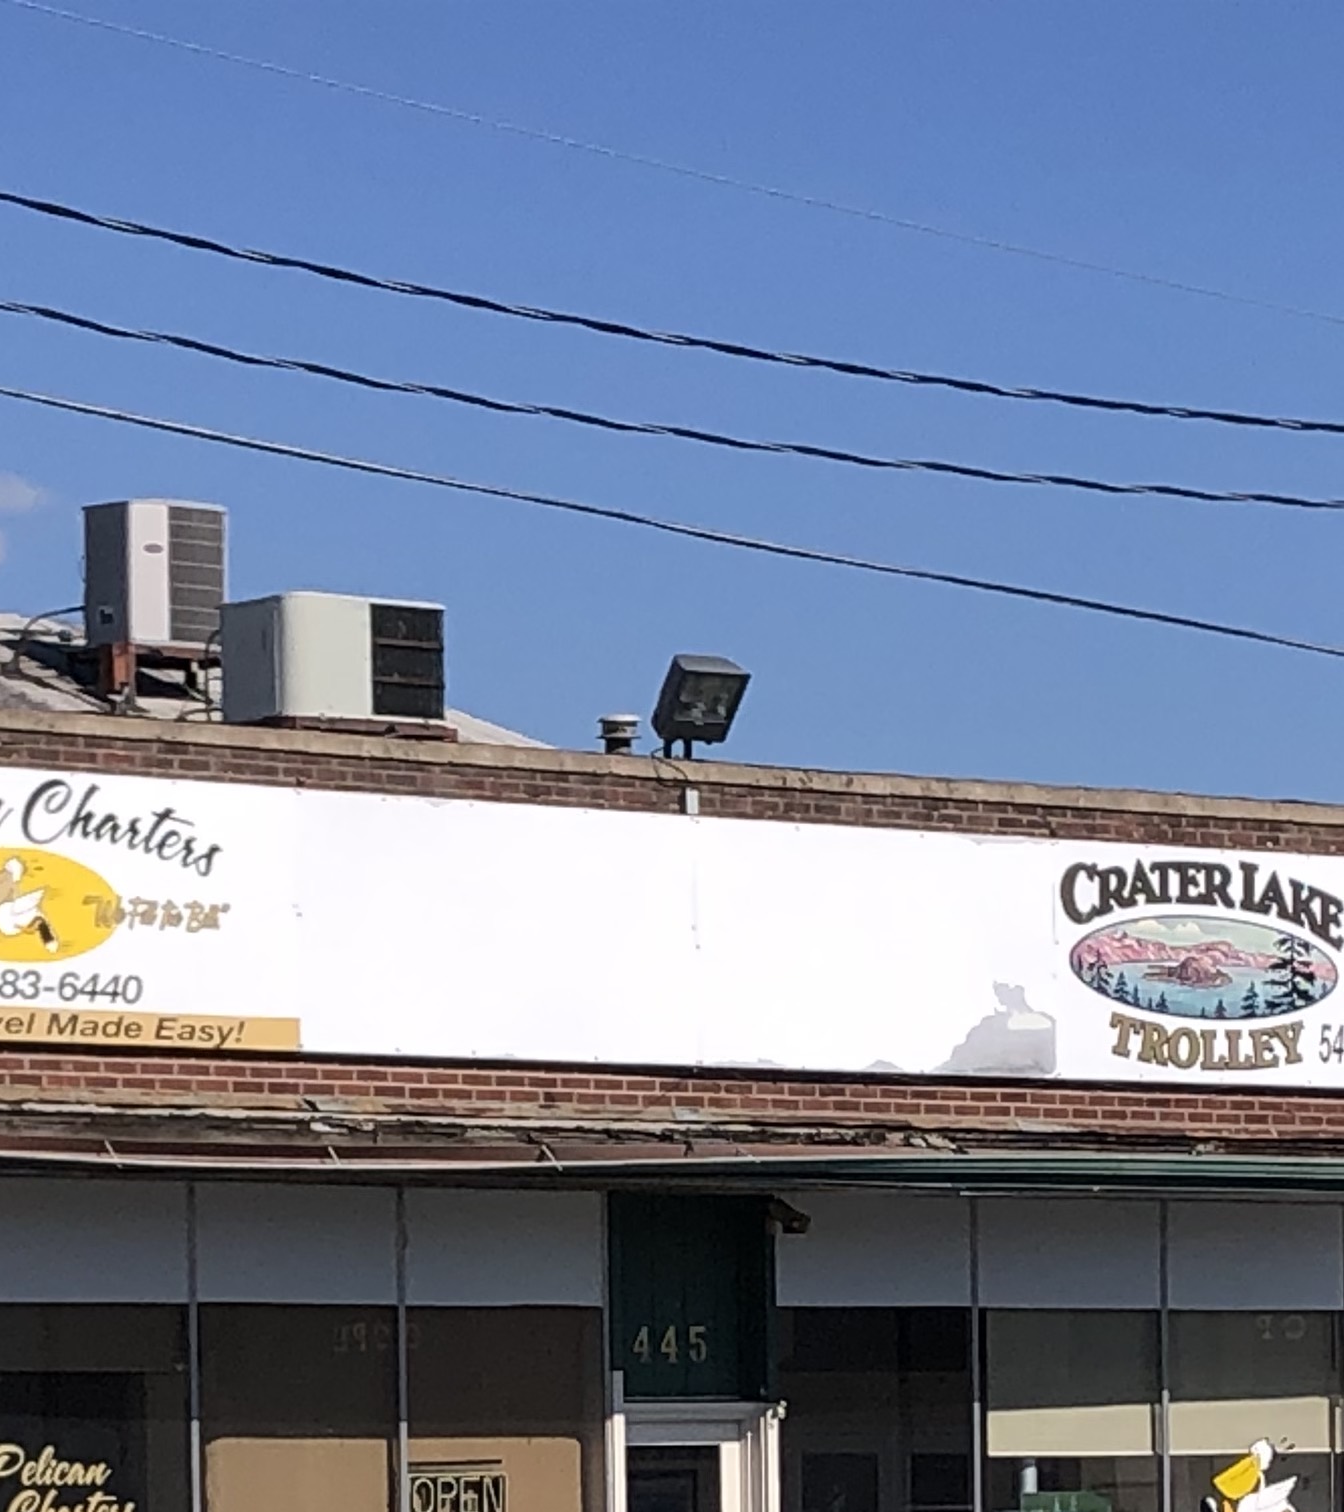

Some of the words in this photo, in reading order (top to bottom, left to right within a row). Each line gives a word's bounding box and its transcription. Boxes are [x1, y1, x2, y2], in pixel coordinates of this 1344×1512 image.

[21, 779, 223, 877] Charters
[1059, 858, 1237, 925] CRATER
[46, 1011, 143, 1039] Made
[154, 1016, 246, 1049] Easy!
[1109, 1011, 1306, 1071] TROLLEY
[633, 1325, 708, 1364] 445
